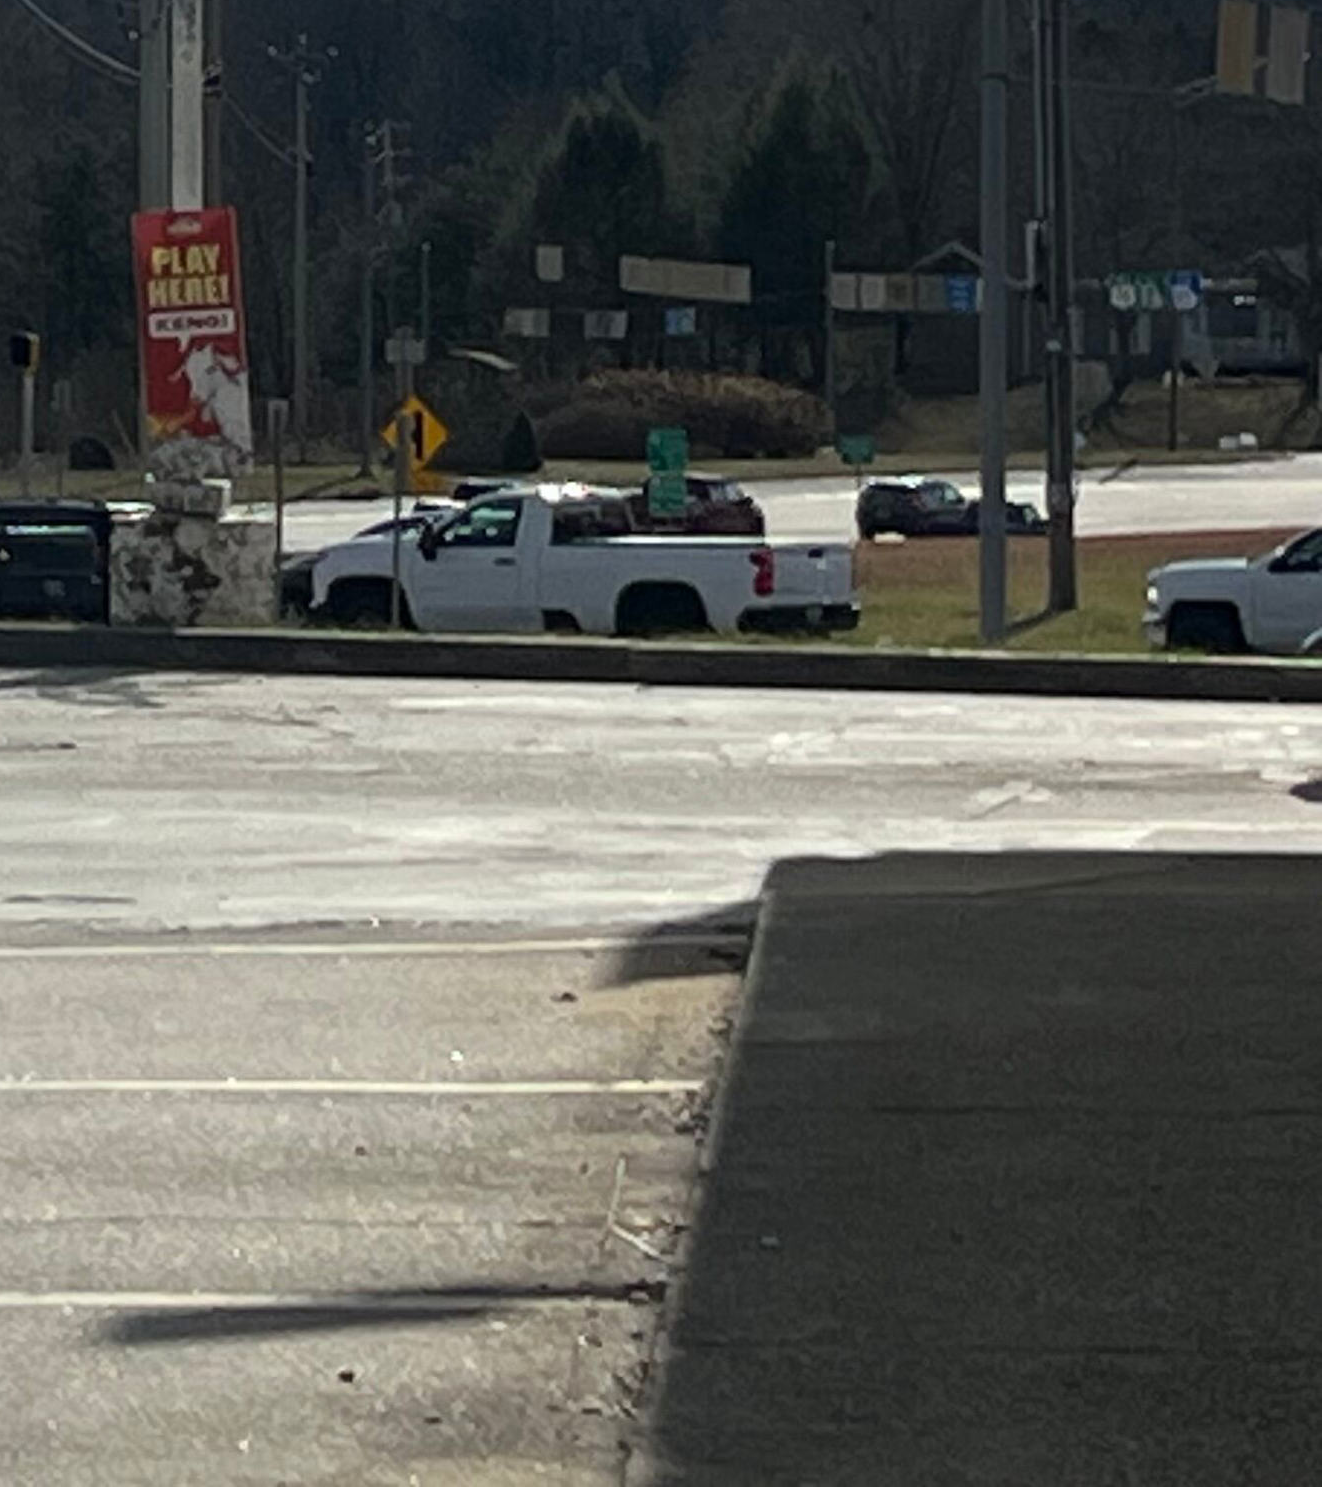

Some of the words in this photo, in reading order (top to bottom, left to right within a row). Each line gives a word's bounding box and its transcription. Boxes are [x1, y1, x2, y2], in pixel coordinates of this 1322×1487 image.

[150, 243, 221, 276] PLAY
[147, 274, 231, 308] HERE!
[153, 313, 229, 332] KENO!
